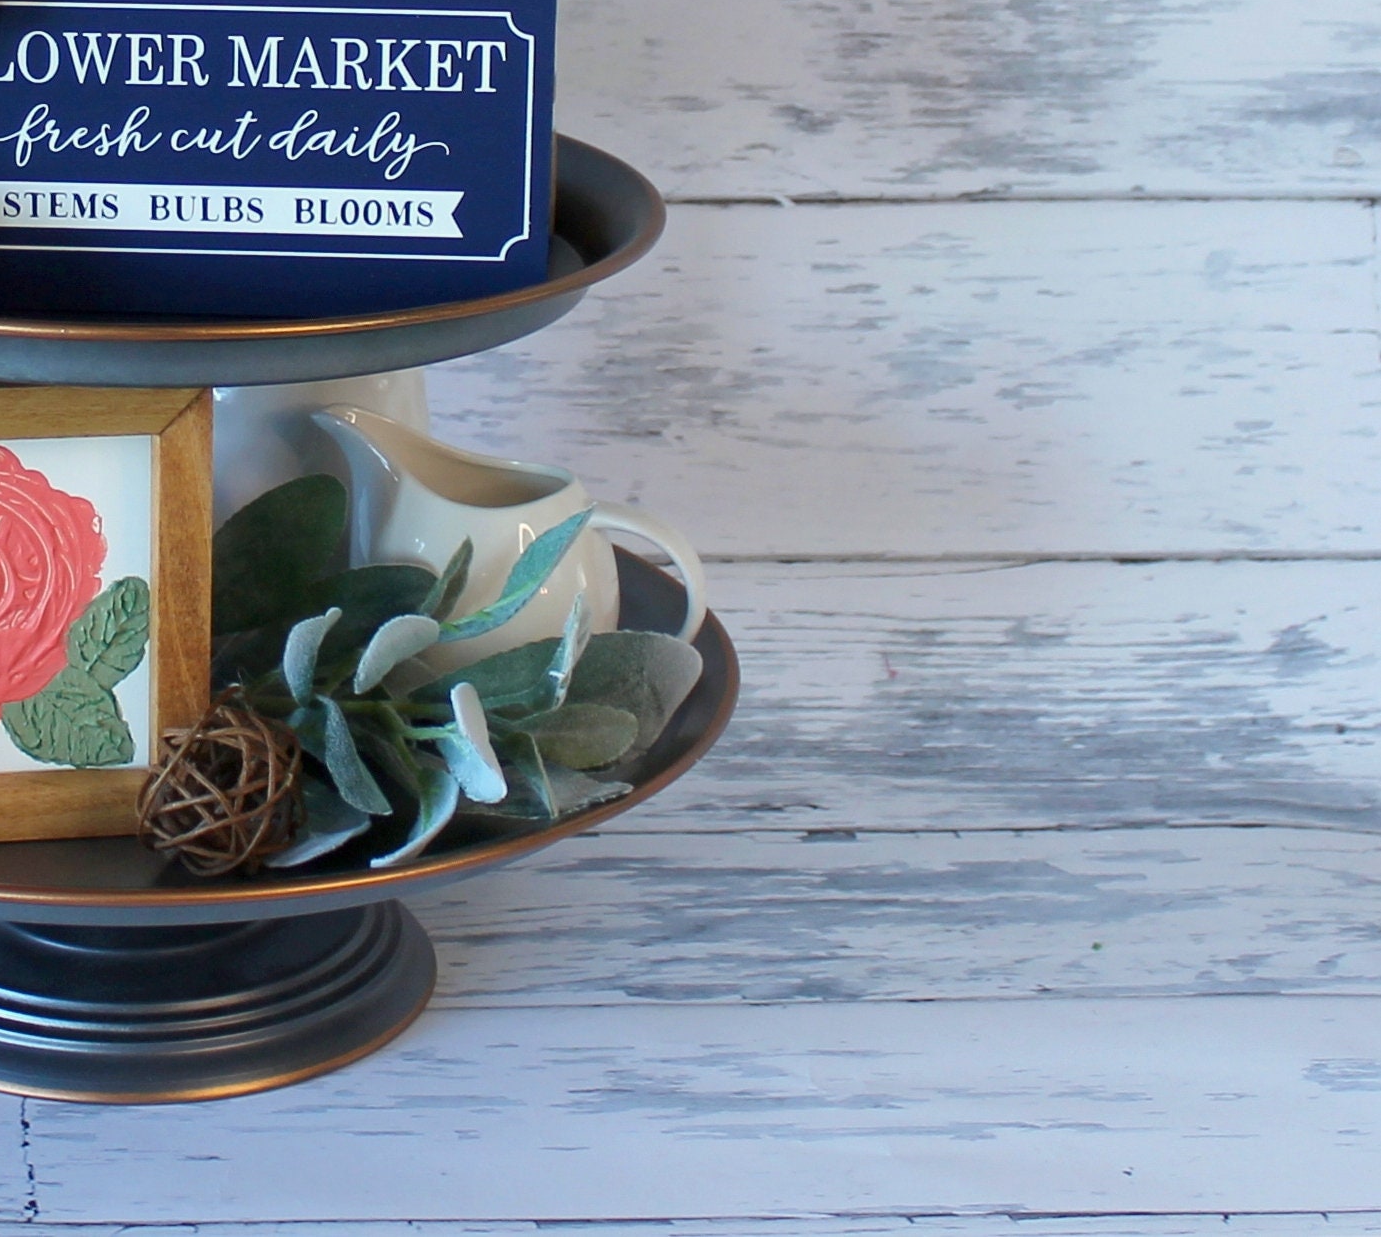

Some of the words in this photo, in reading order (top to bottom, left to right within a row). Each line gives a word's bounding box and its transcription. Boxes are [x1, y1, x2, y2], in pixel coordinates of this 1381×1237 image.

[227, 34, 507, 93] MARKET
[169, 109, 258, 161] cut
[268, 110, 450, 181] daily
[1, 191, 120, 221] STEMS
[148, 194, 265, 224] BULBS
[293, 197, 435, 228] BLOOMS
